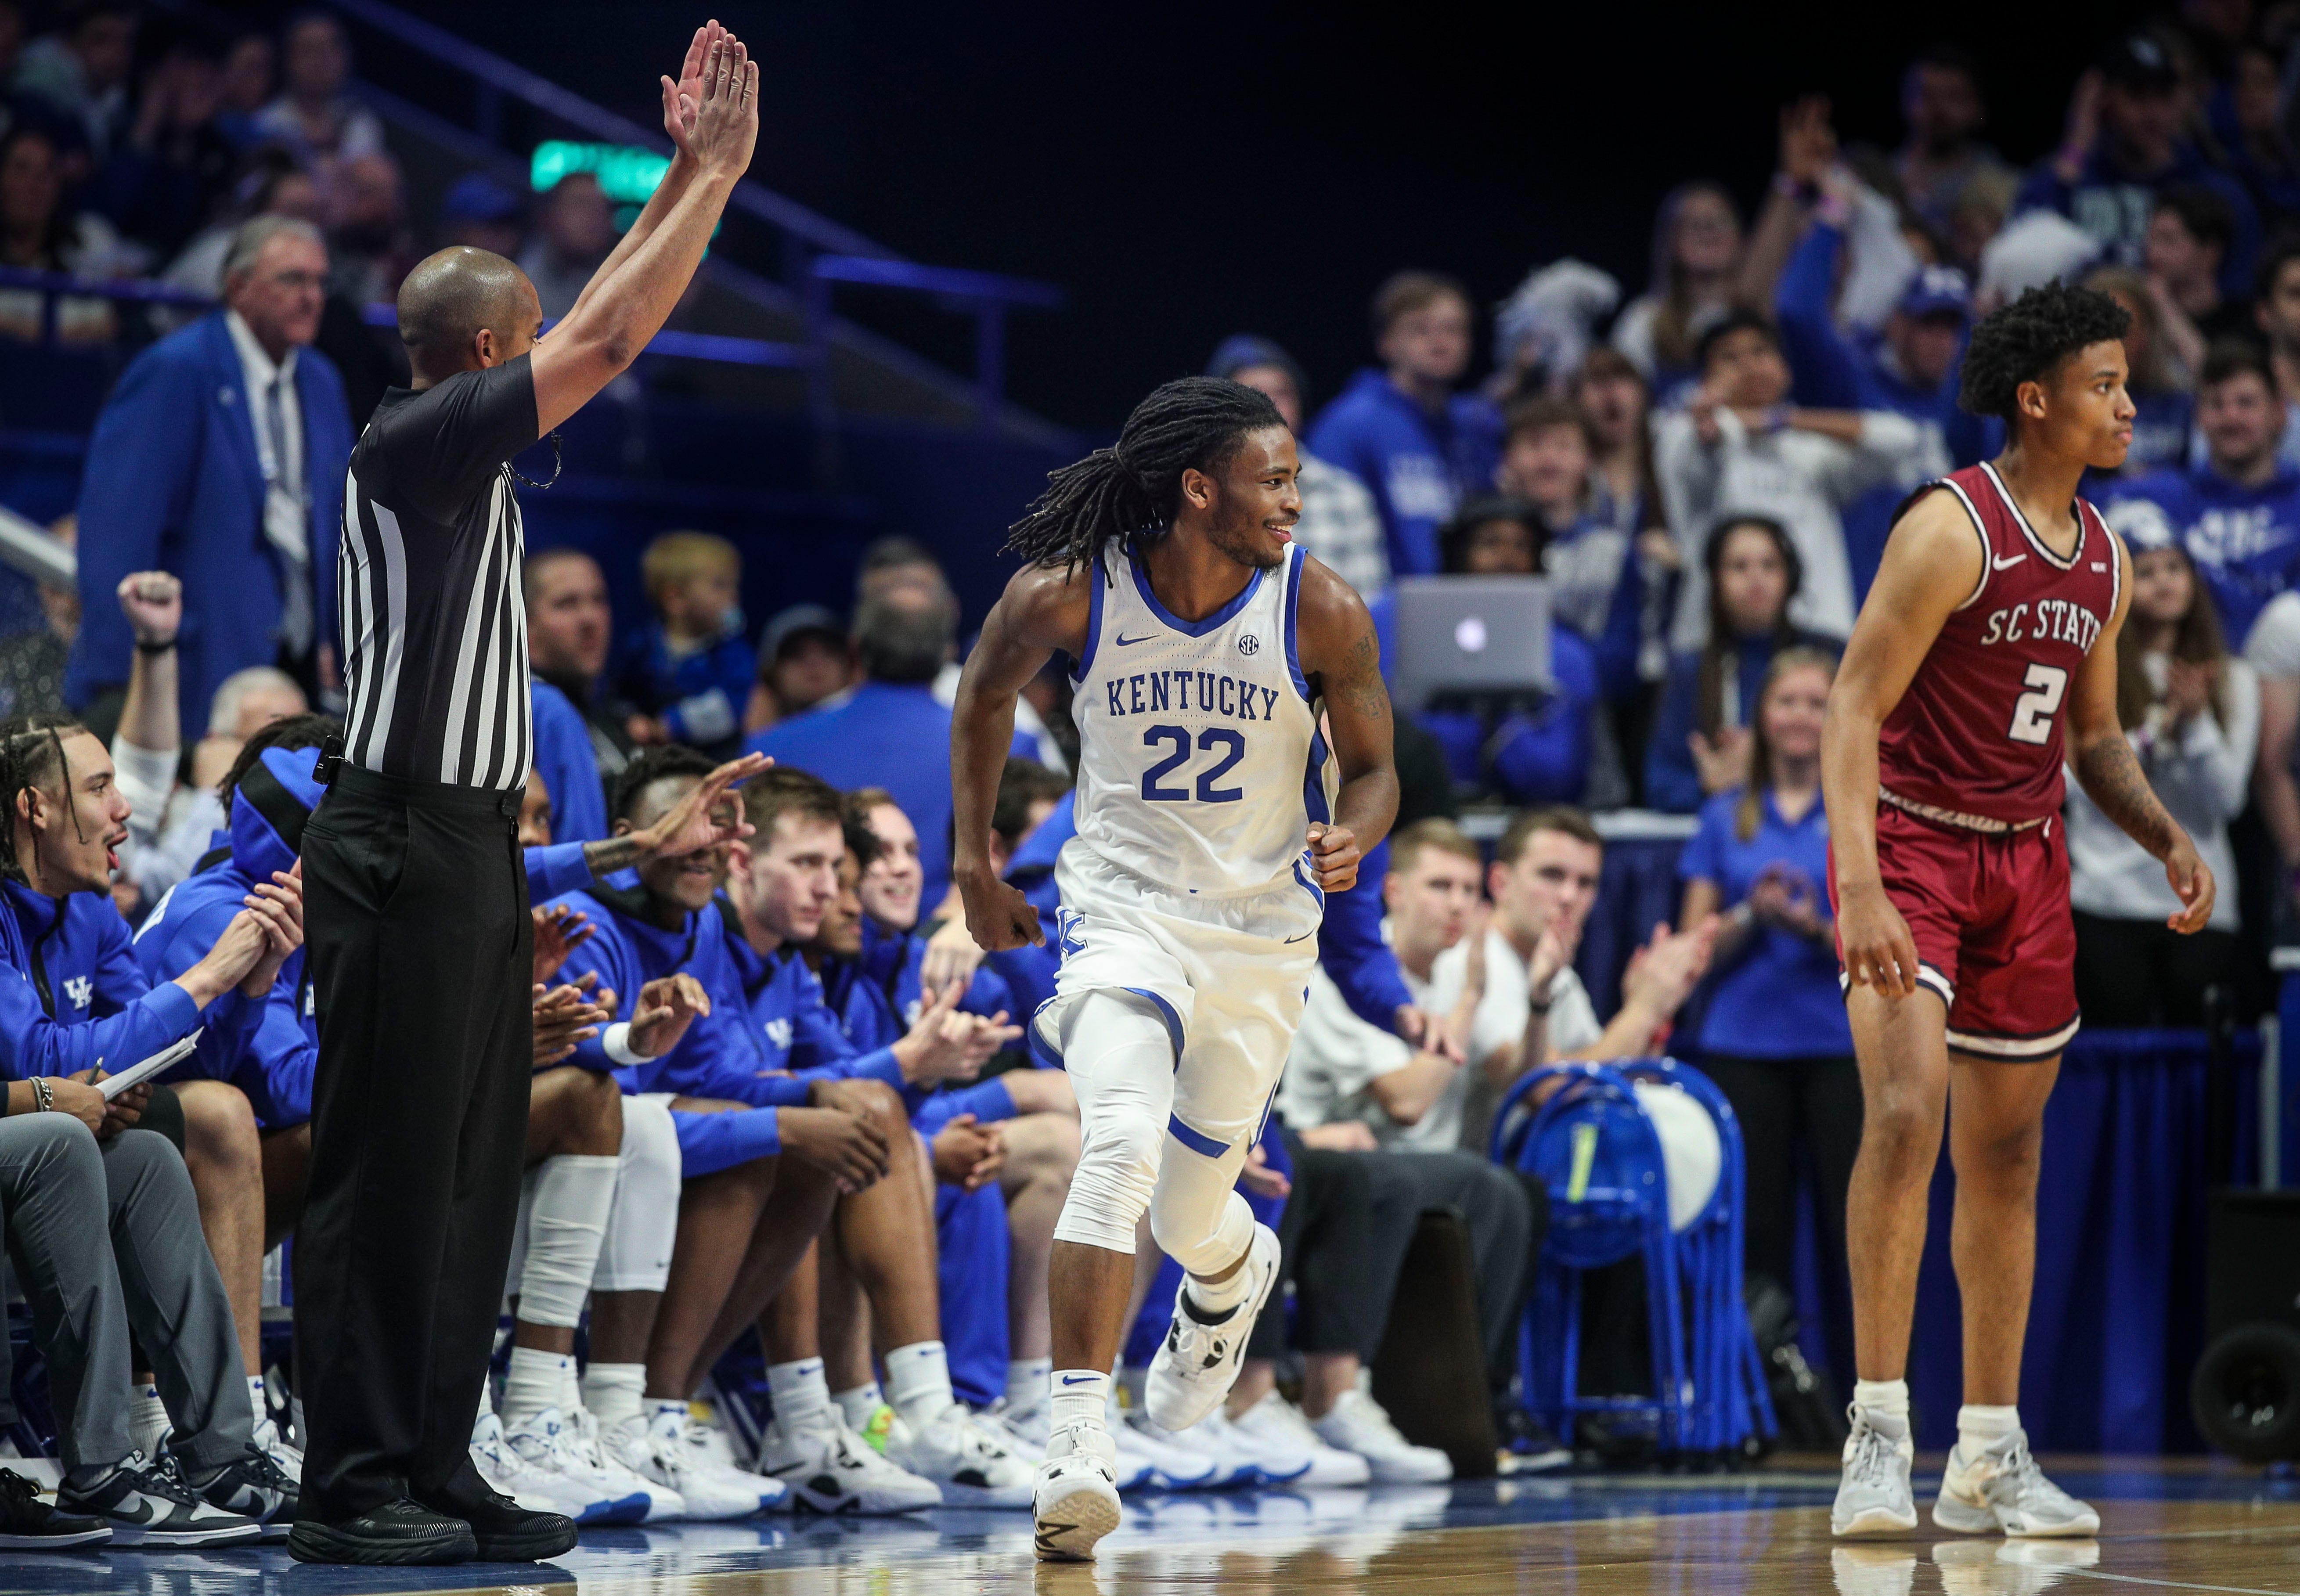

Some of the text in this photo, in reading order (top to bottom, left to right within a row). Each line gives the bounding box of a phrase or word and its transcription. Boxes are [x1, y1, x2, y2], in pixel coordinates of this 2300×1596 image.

[1240, 636, 1258, 654] SEC
[1980, 603, 2029, 645] SC
[1107, 671, 1279, 721] KENTUCKY
[2008, 662, 2068, 746] 2
[1142, 724, 1245, 802] 22
